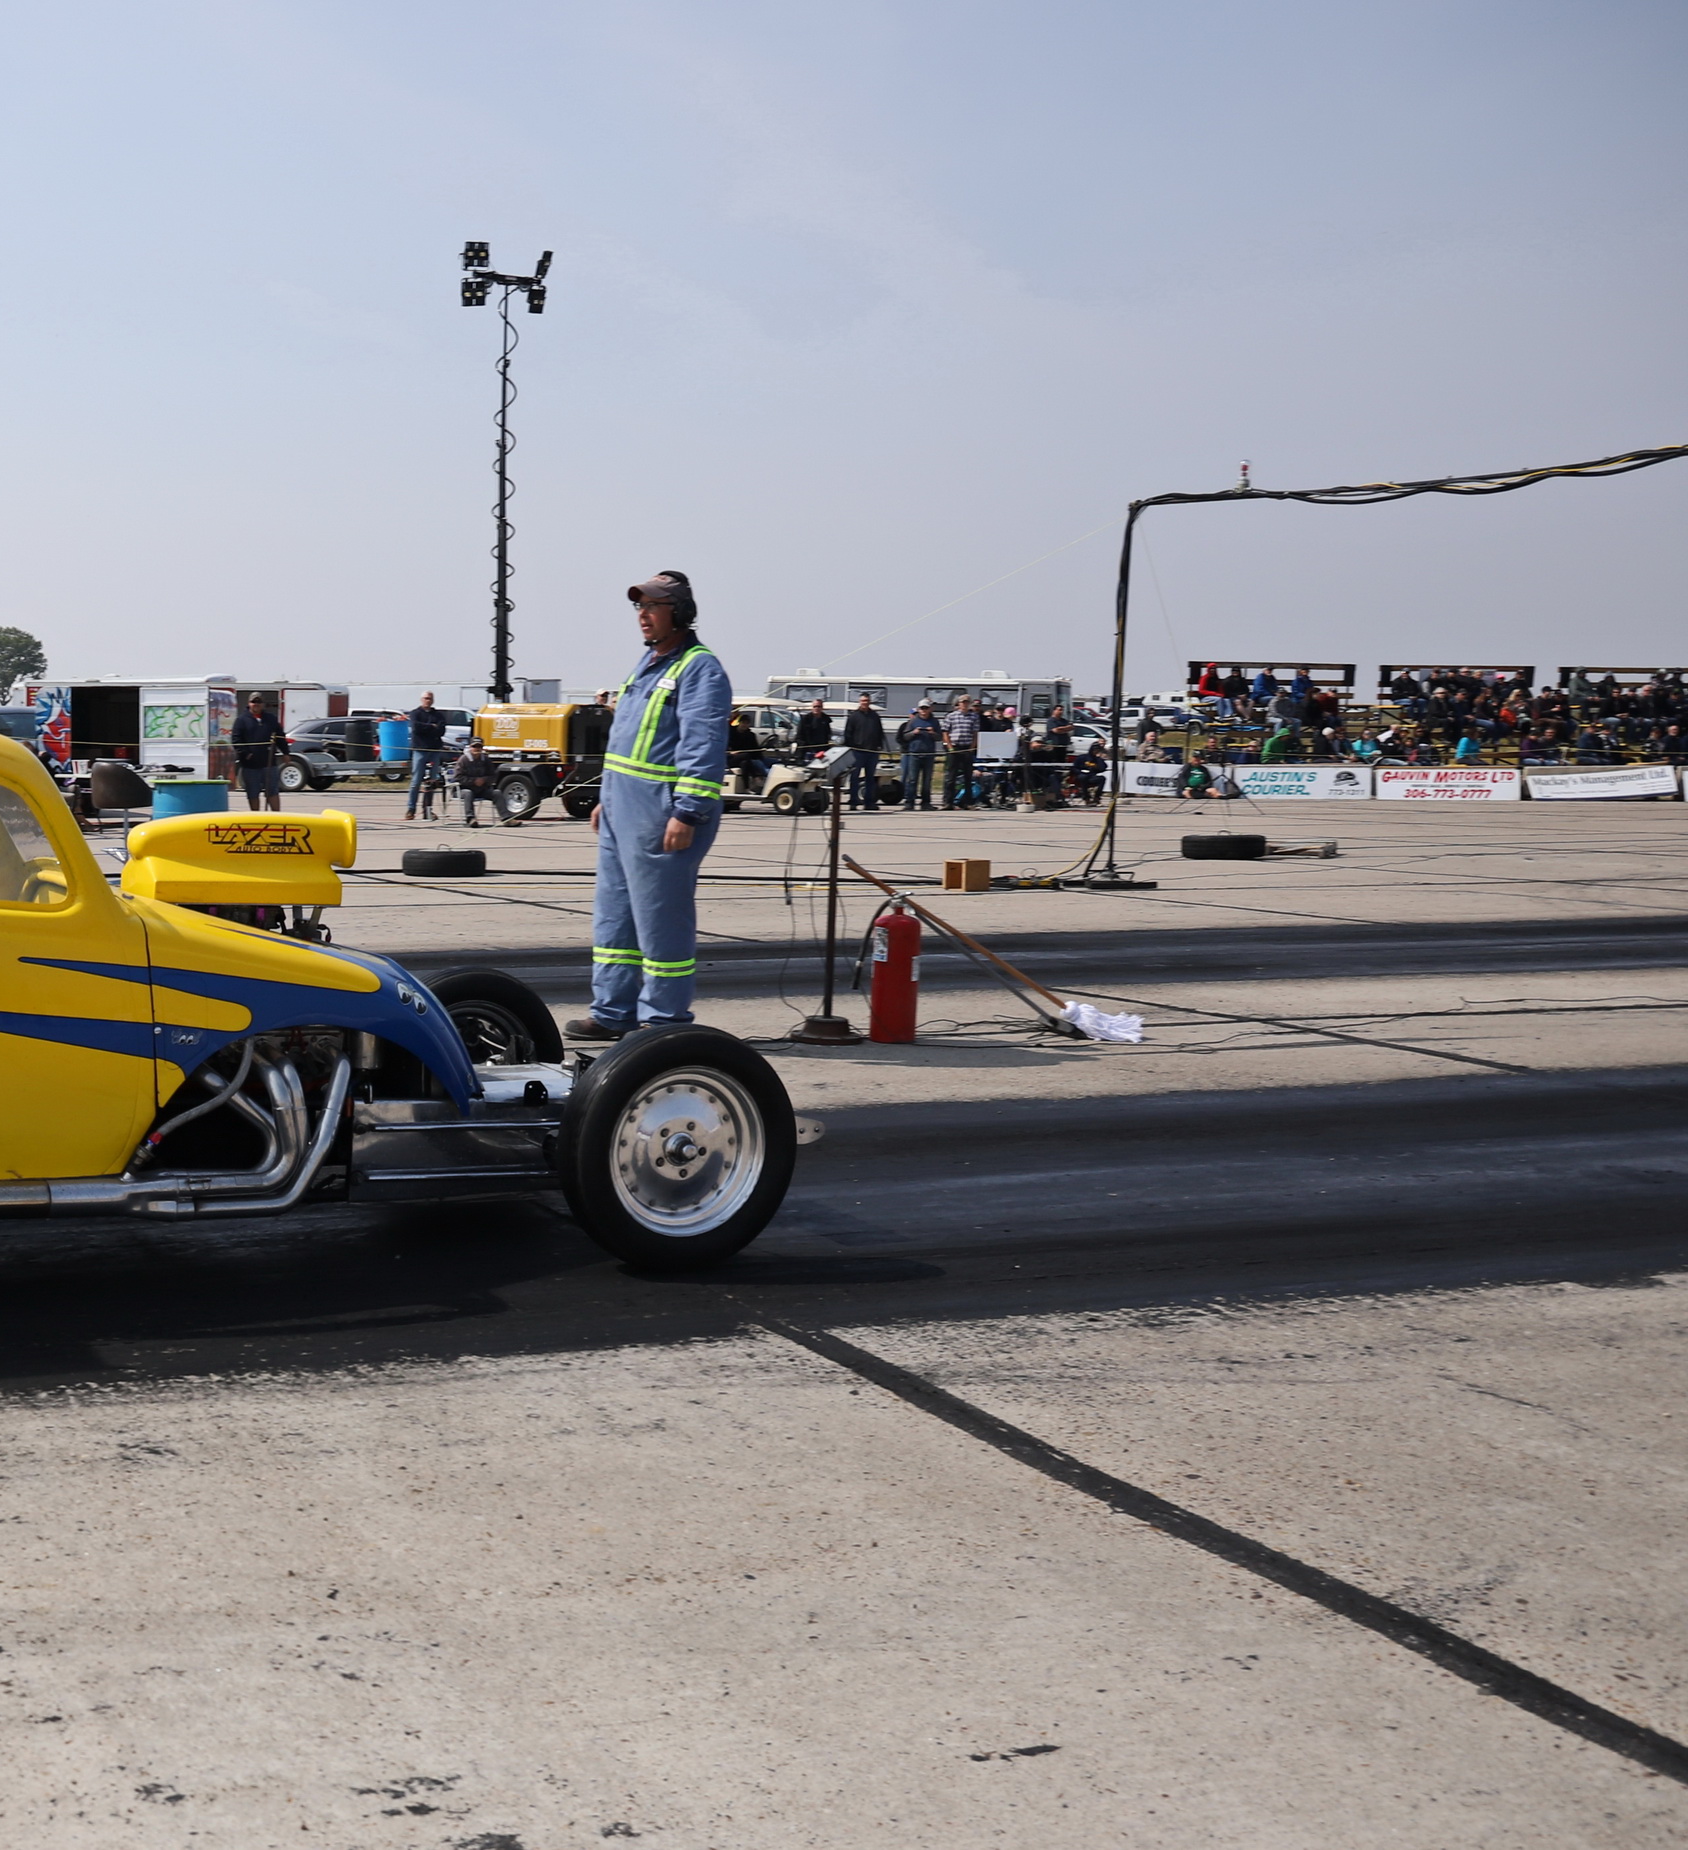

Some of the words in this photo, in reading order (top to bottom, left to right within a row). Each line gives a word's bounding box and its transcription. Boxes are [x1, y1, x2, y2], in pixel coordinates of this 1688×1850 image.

[1241, 771, 1317, 782] AUSTIN'S
[1381, 771, 1430, 782] GAUVIN
[1433, 771, 1488, 783] MOTORS
[1490, 771, 1516, 783] LTD
[1579, 772, 1646, 786] Management
[1241, 784, 1310, 795] COURIER
[1403, 789, 1492, 798] 306-773-0777
[206, 823, 314, 855] LAZER
[236, 845, 262, 853] AUTO
[267, 845, 293, 853] BODY
